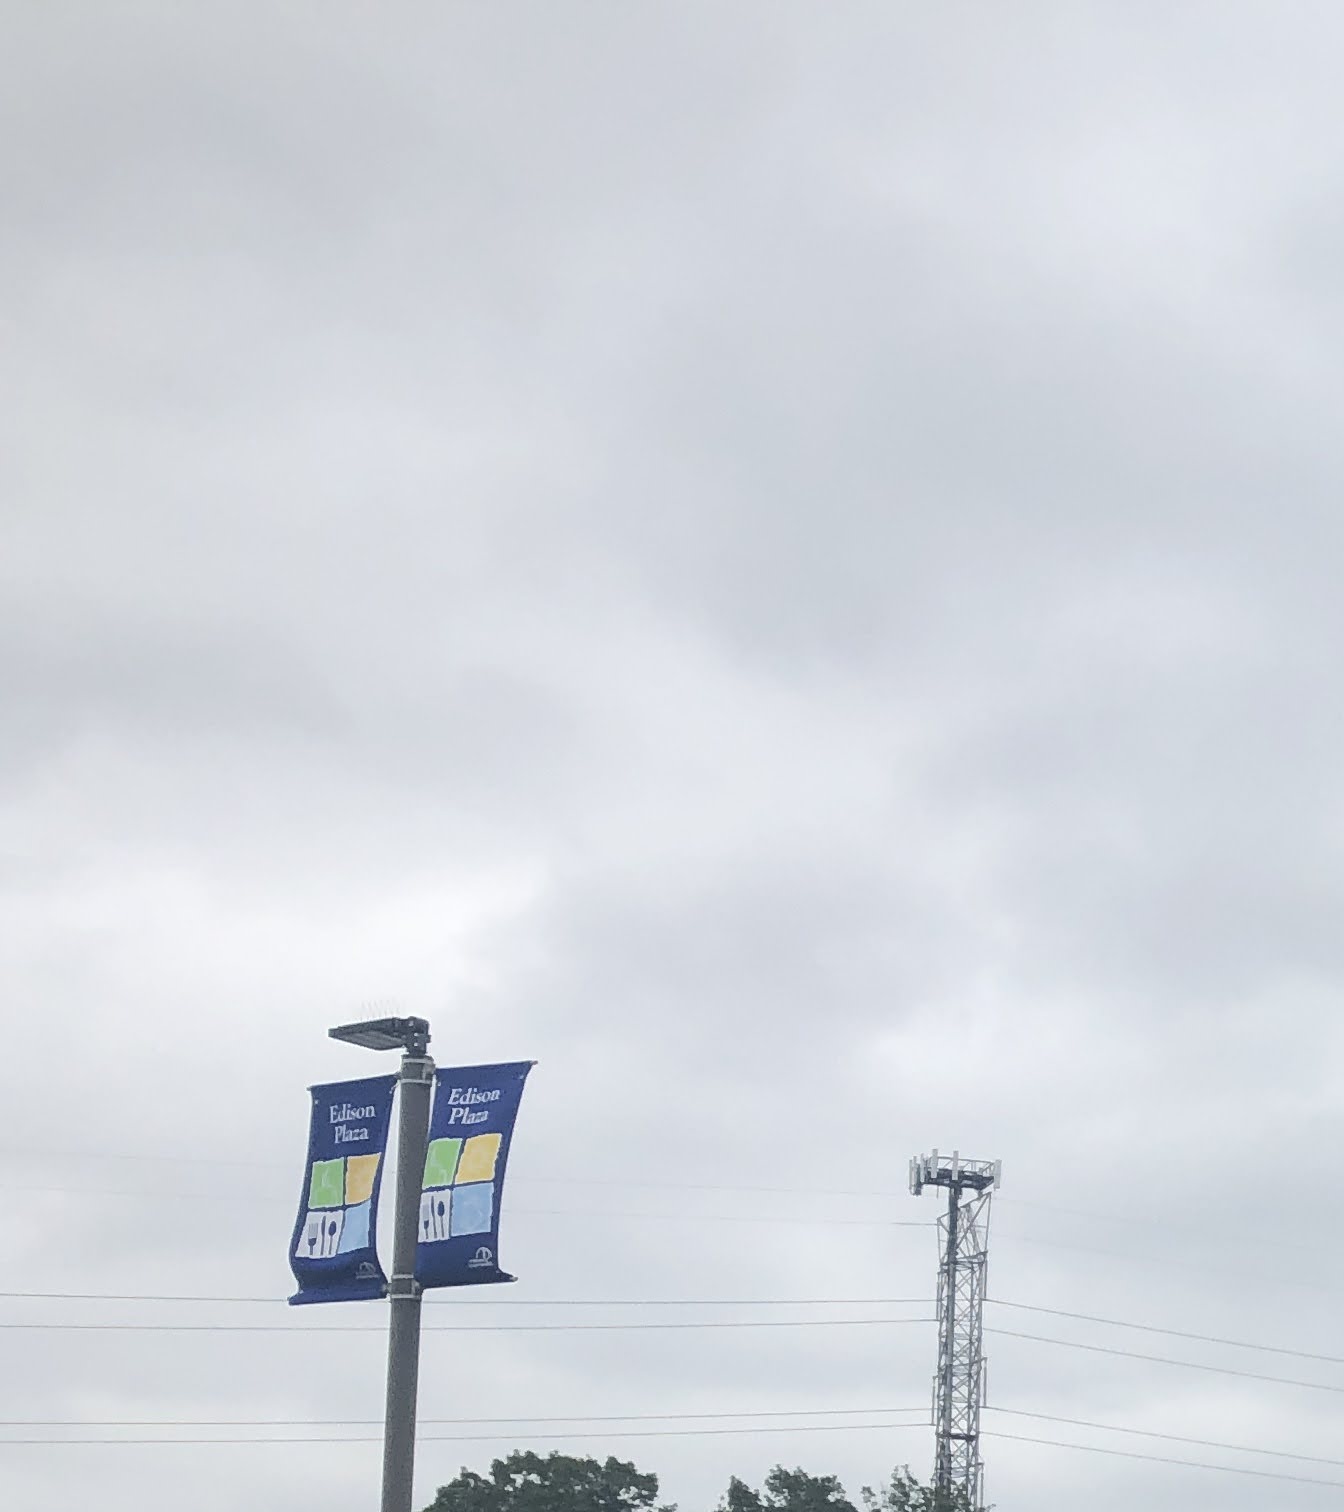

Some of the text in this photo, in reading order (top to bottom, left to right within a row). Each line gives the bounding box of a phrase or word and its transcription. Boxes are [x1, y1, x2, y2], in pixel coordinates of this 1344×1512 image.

[447, 1088, 500, 1105] Edison
[329, 1103, 377, 1124] Edison
[448, 1107, 488, 1125] Plaza
[333, 1125, 370, 1144] Plaza
